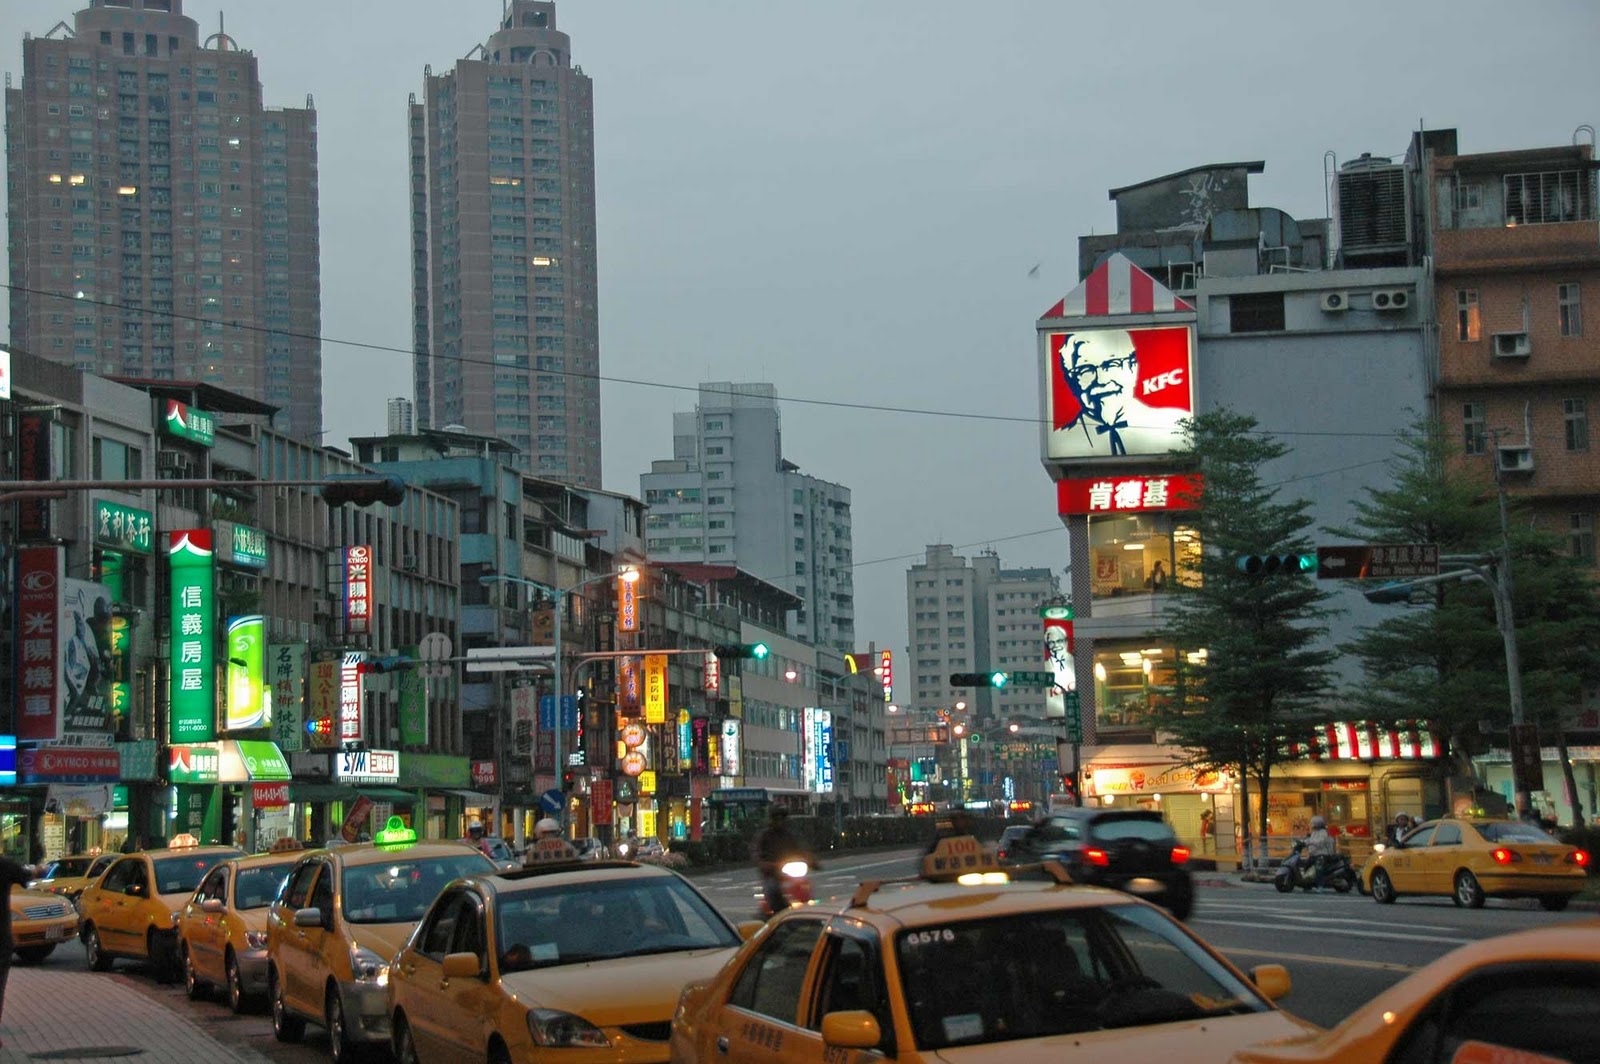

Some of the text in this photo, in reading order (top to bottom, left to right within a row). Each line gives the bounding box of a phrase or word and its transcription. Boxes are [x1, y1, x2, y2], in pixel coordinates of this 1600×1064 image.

[1143, 368, 1183, 395] KFC
[1089, 479, 1169, 511] 肯德基
[181, 585, 203, 692] 信義房屋
[23, 611, 52, 717] 光陽機車
[1049, 682, 1076, 697] KC
[57, 756, 89, 769] KYMCO
[344, 752, 366, 774] SYM
[946, 841, 977, 854] 100
